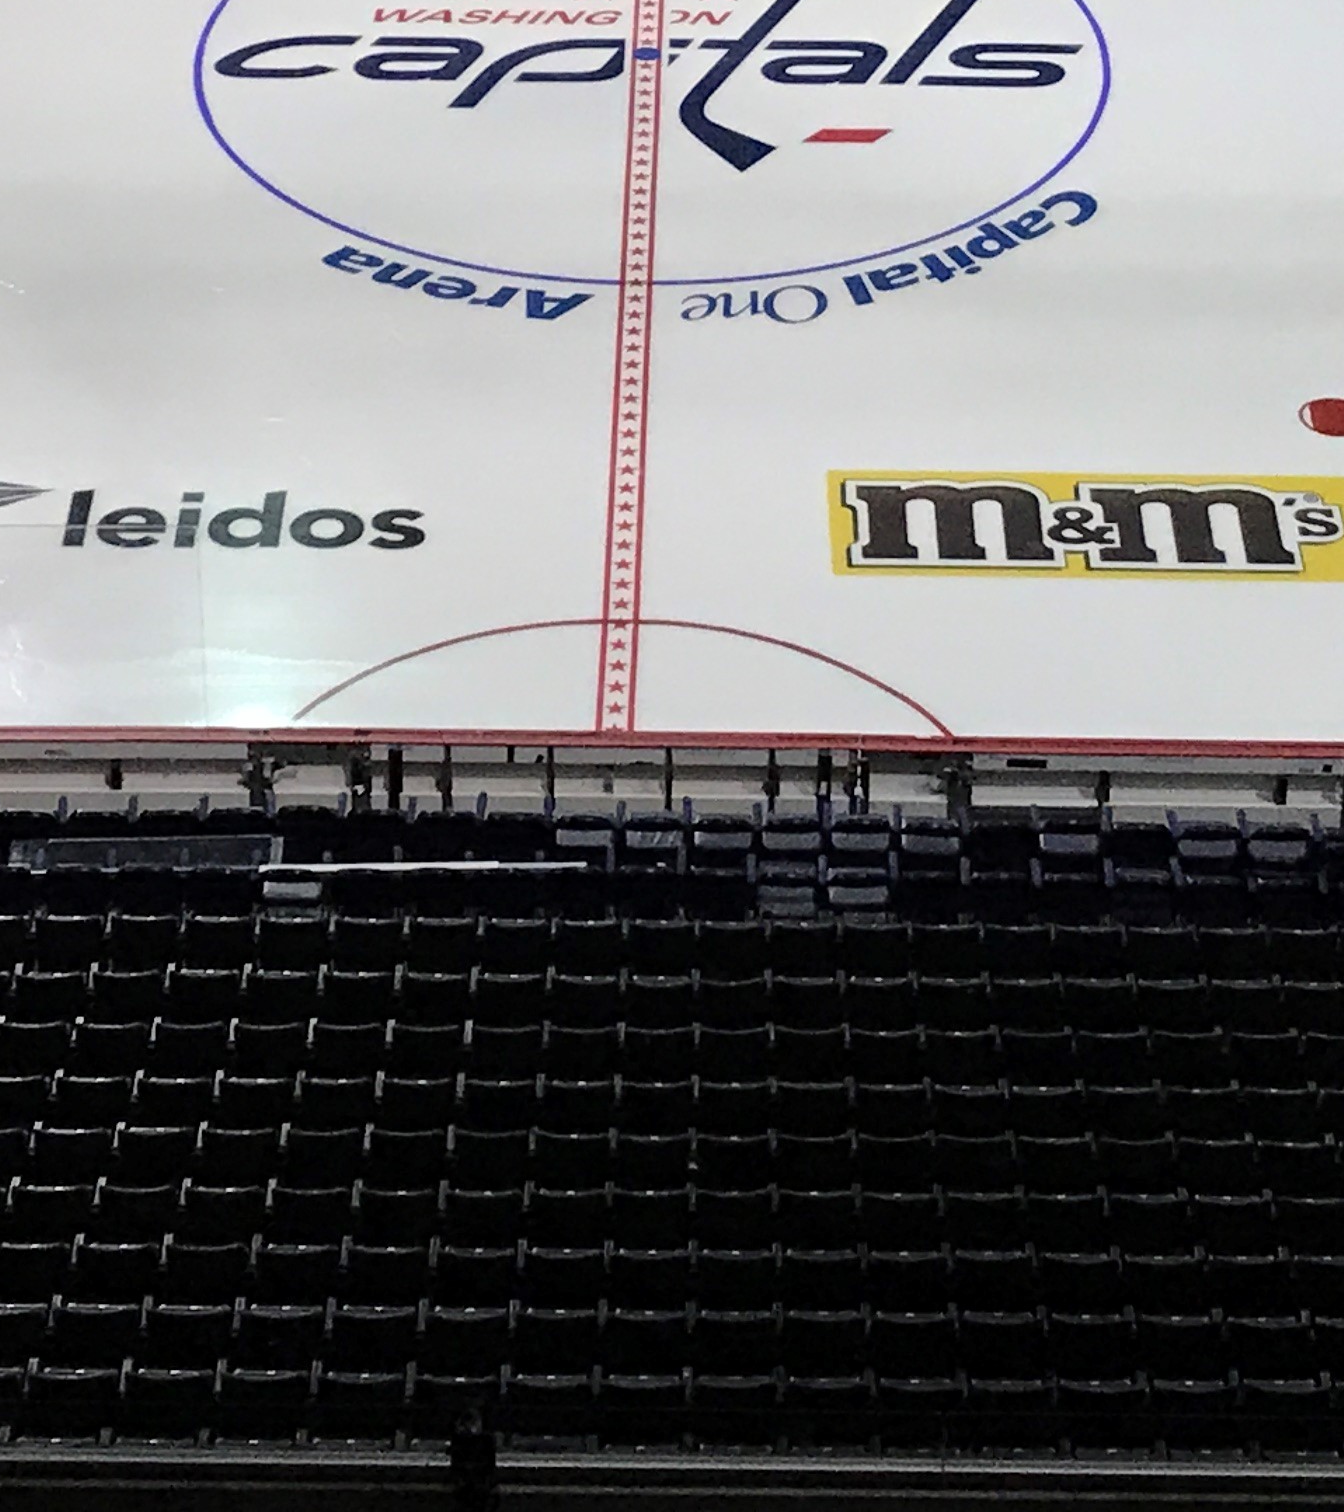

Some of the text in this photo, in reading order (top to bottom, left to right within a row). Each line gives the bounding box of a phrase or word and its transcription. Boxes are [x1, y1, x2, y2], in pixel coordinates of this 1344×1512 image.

[372, 8, 732, 26] WASHINGN
[322, 190, 1098, 325] Capital One Arena
[61, 489, 426, 549] leidos
